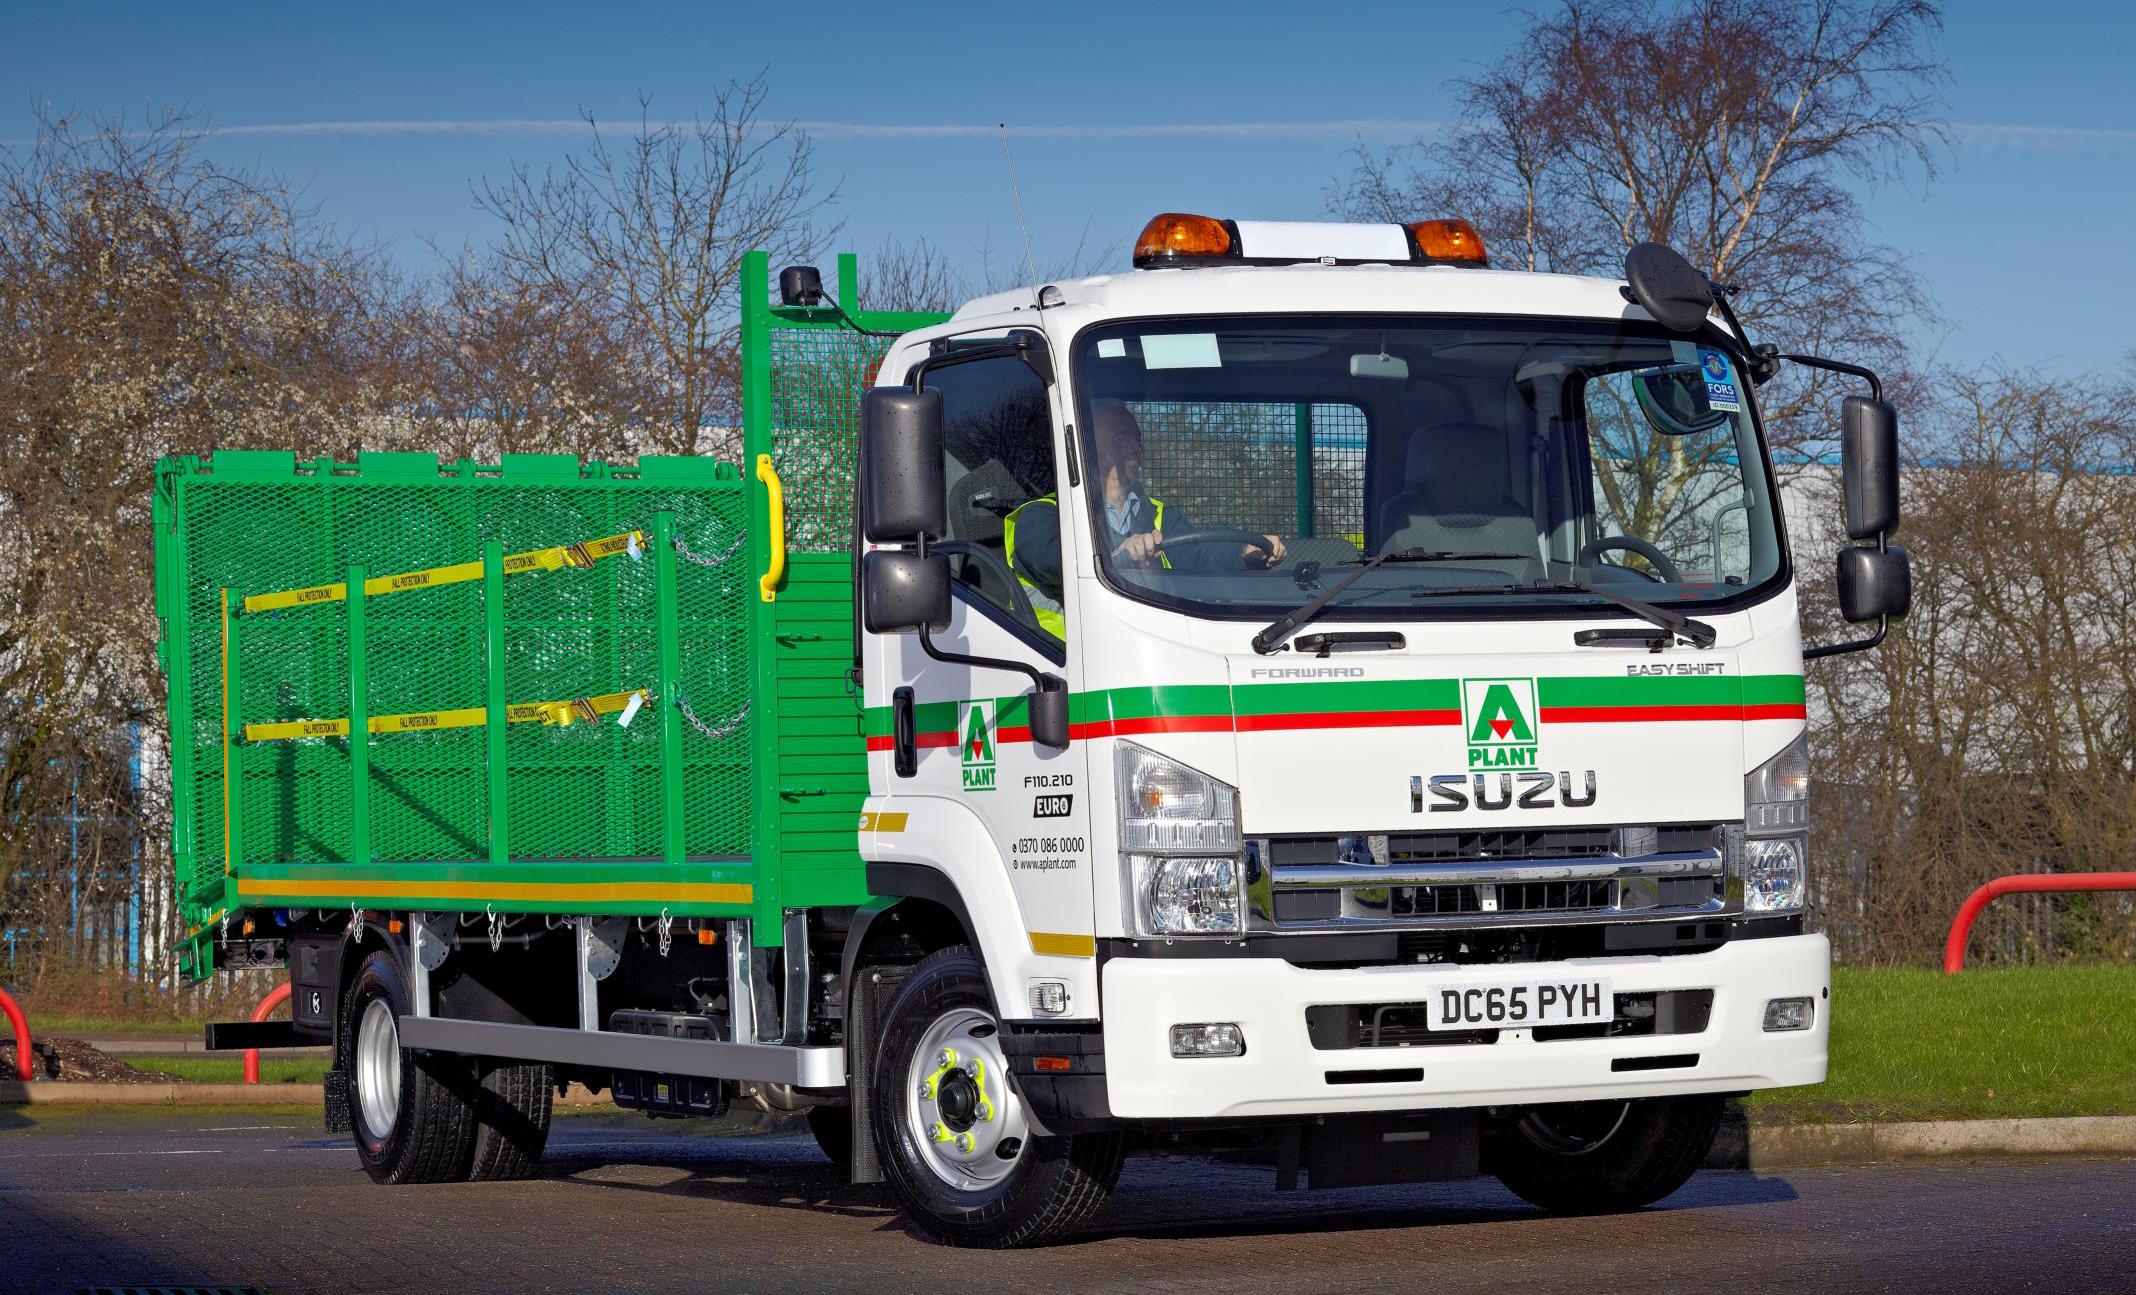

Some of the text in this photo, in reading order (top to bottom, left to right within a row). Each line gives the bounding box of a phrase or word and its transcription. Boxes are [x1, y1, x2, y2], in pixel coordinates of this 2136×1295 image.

[1708, 383, 1734, 395] FORS
[400, 575, 420, 587] PROTECTION
[304, 590, 323, 601] PROTECTION
[1251, 667, 1364, 678] FORWARD
[1471, 685, 1533, 740] A
[312, 723, 330, 733] PROTECTION
[408, 715, 428, 727] PROTECTION
[964, 705, 994, 761] A
[1468, 747, 1538, 766] PLANT
[963, 768, 996, 786] PLANT
[1024, 774, 1073, 788] F110.210
[1410, 770, 1596, 813] ISUZU
[1019, 837, 1085, 853] 0370 086 0000
[1019, 857, 1077, 873] www.aplant.com
[1441, 983, 1601, 1024] DC65 PYH
